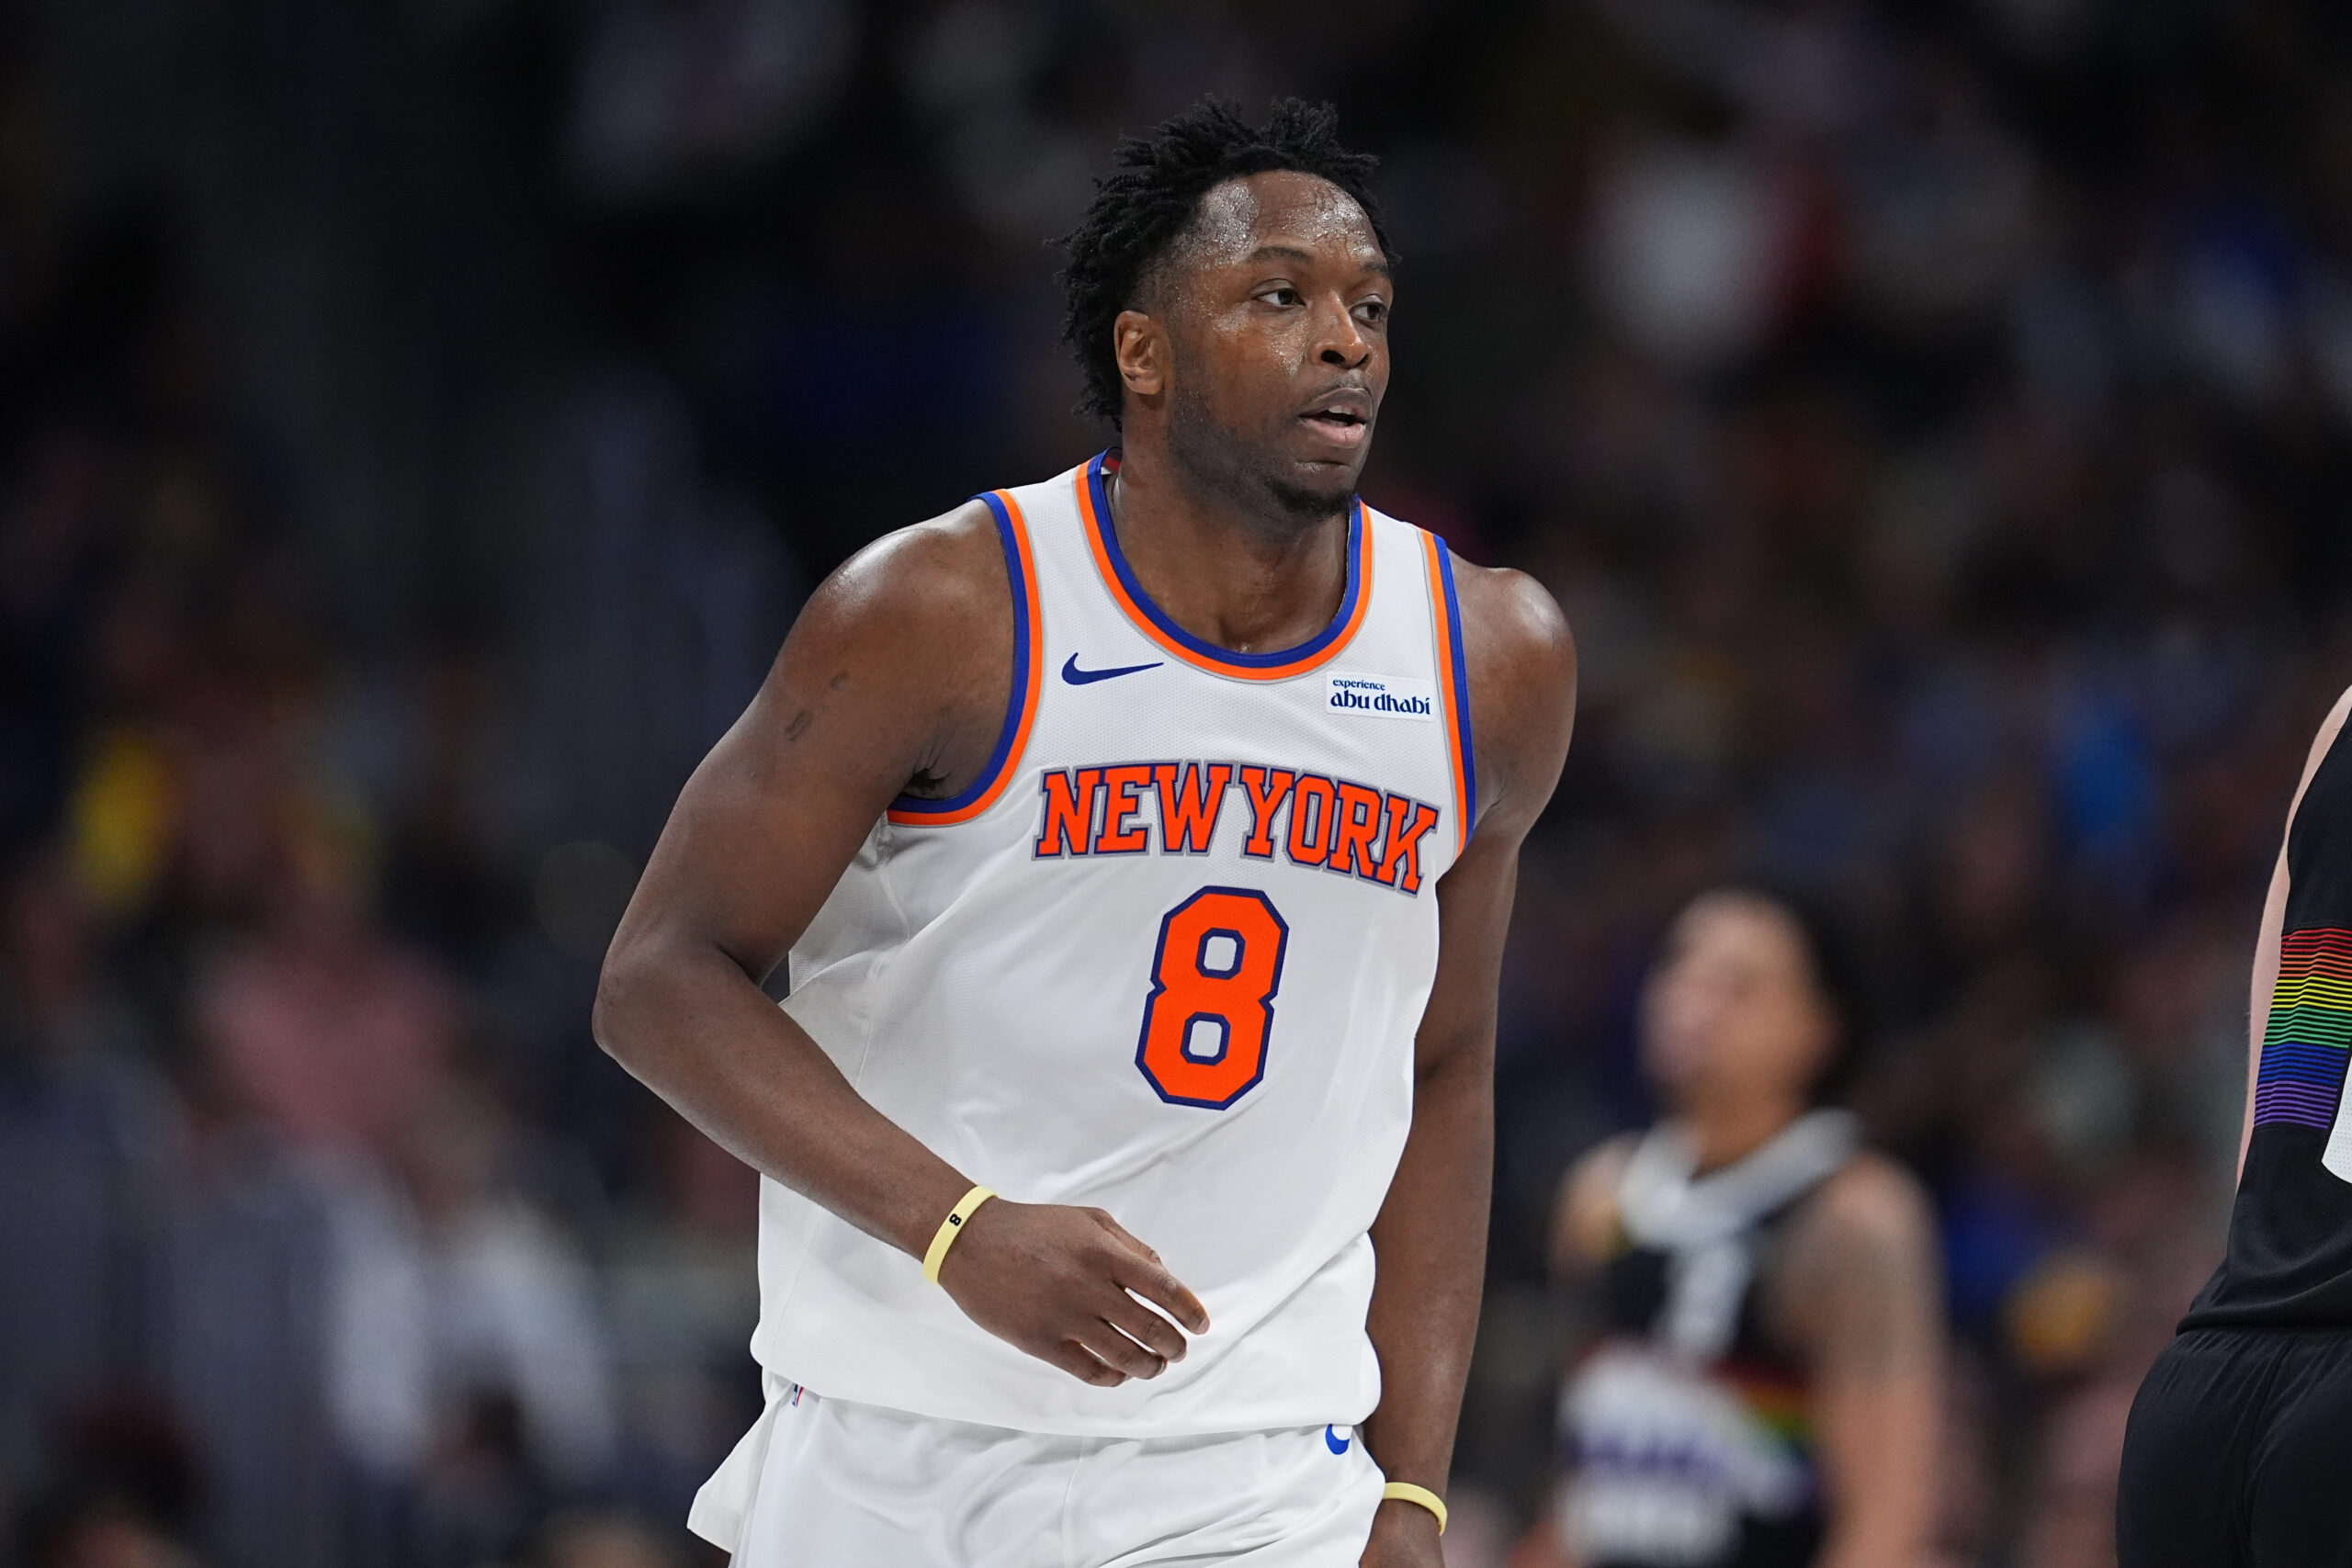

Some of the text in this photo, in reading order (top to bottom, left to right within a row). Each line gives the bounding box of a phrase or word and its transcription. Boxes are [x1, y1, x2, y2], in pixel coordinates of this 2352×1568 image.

[1332, 679, 1385, 691] experience
[1330, 690, 1430, 715] abu dhabi
[1032, 760, 1441, 897] NEW YORK
[1135, 885, 1289, 1111] 8
[949, 1213, 962, 1226] 8
